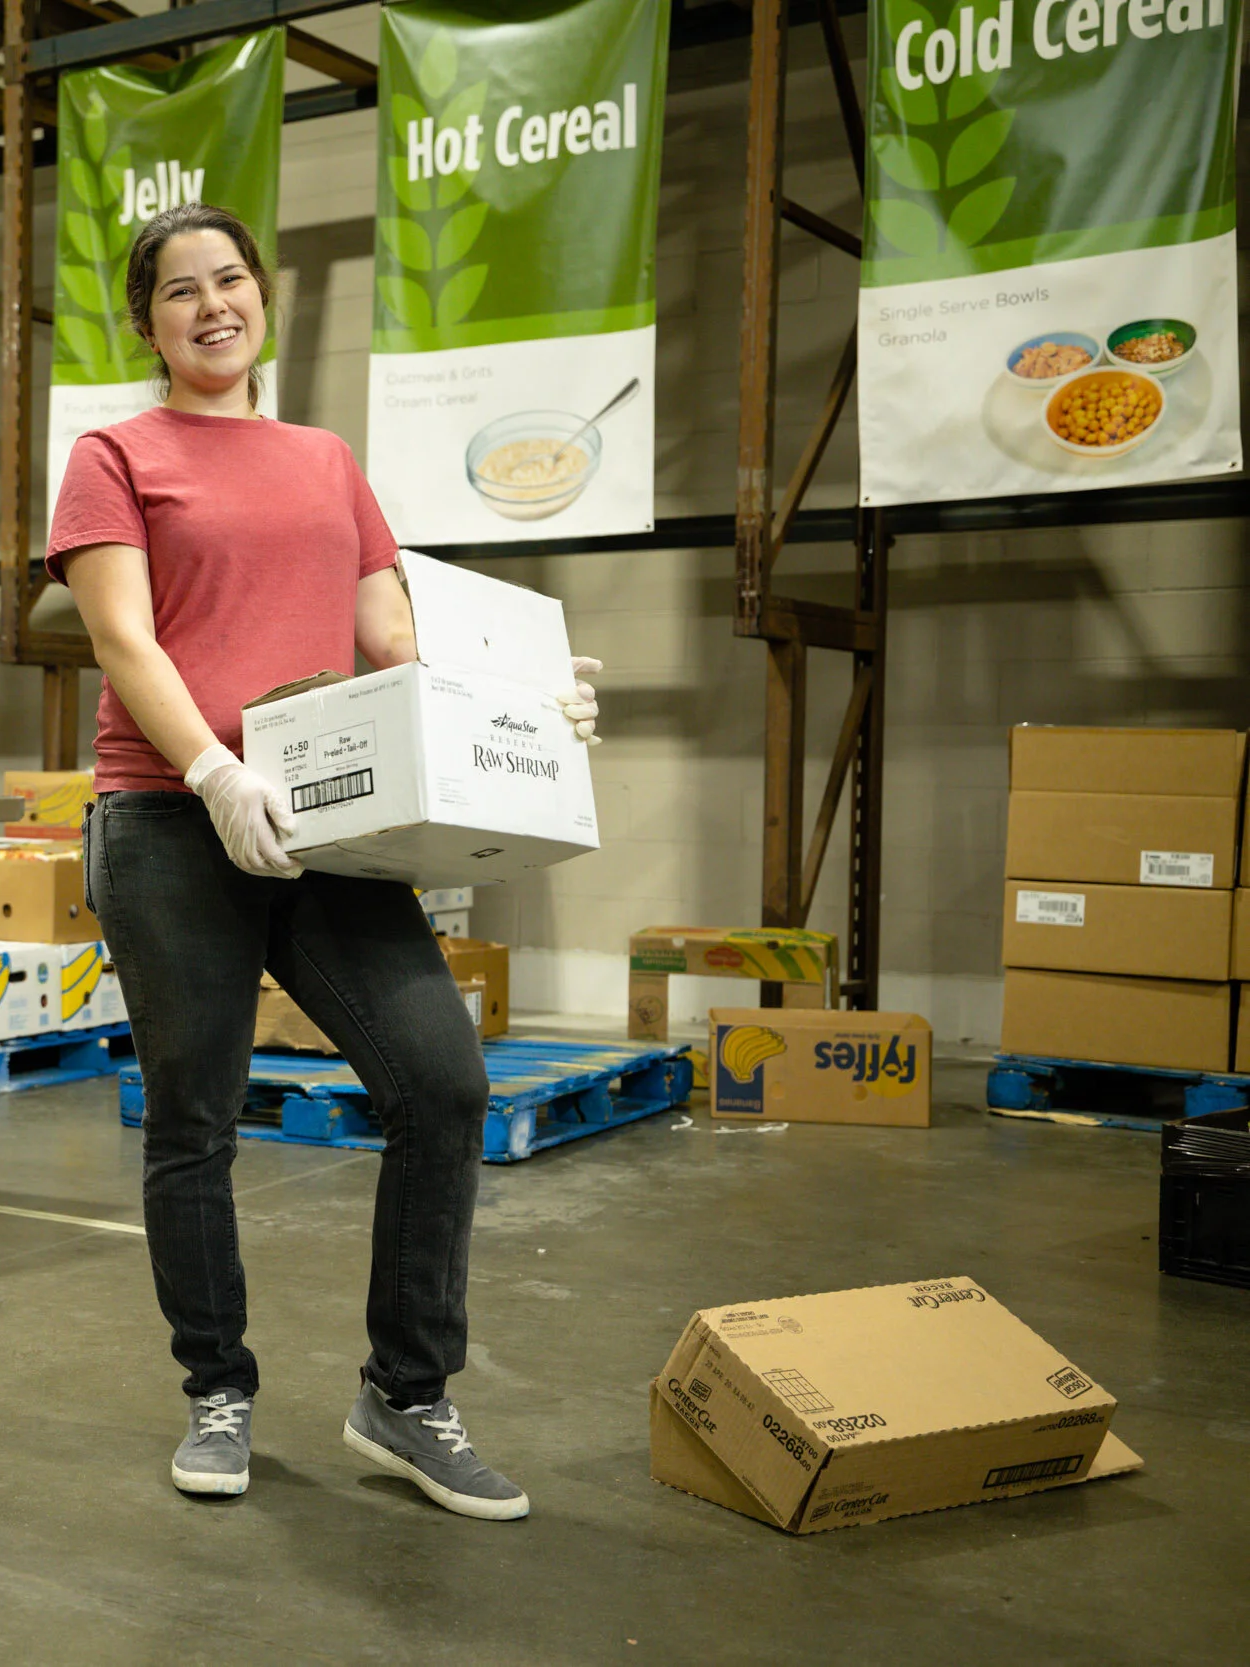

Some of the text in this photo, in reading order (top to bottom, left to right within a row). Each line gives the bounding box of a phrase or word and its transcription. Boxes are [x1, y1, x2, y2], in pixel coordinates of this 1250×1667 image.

[894, 0, 1225, 91] Cold Cereal
[406, 83, 638, 182] Hot Cereal
[879, 286, 1050, 323] Single Serve Bowls
[877, 328, 948, 348] Granola
[384, 390, 478, 408] Cream Cereal
[499, 712, 538, 735] AquaStar
[283, 740, 309, 756] 41-50
[339, 735, 352, 745] Raw
[490, 733, 542, 752] RESERVE
[914, 1281, 954, 1293] BACON
[1053, 1370, 1078, 1389] Mayer
[1063, 1379, 1086, 1395] Oscar
[673, 1401, 701, 1432] BACON
